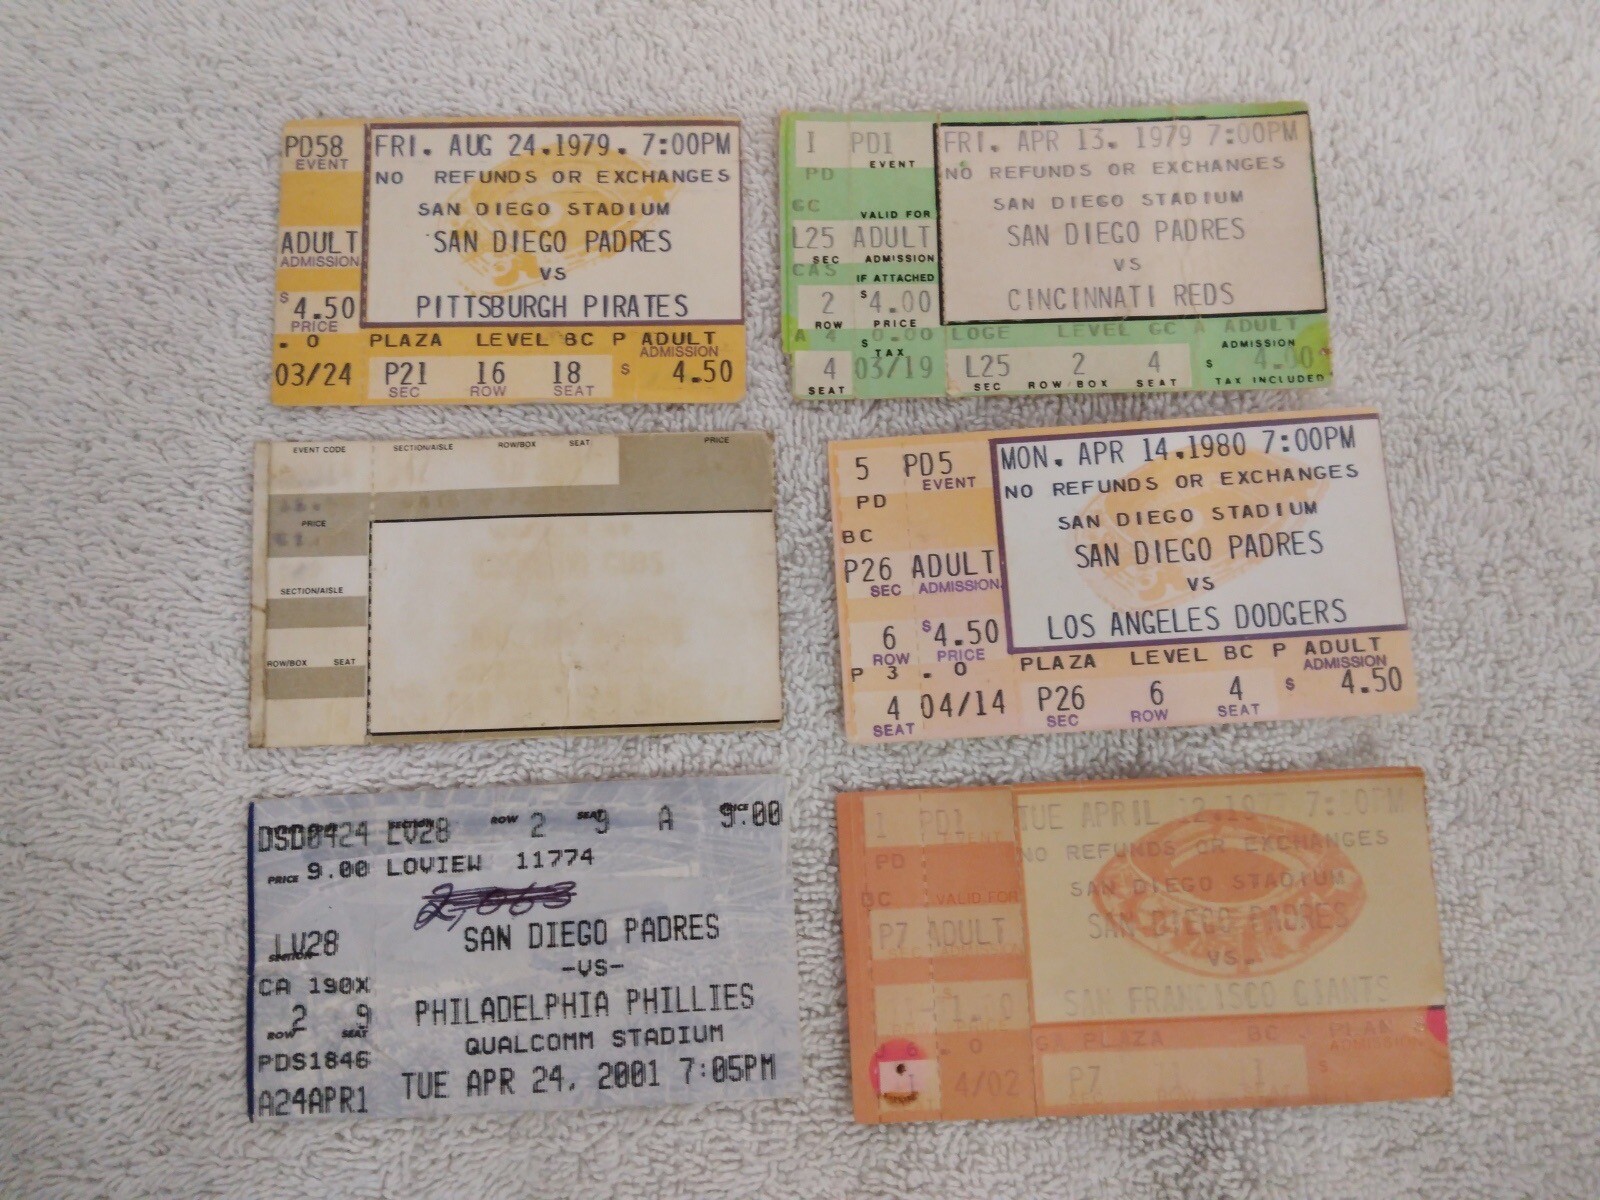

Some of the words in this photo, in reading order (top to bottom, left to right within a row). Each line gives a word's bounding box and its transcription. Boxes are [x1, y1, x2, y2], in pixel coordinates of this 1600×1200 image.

[284, 134, 343, 158] PD58
[450, 133, 492, 157] AUG
[643, 132, 730, 155] 7:00PM
[1017, 130, 1059, 151] APR
[1137, 125, 1192, 149] 1979
[1208, 120, 1298, 146] 7:00PM
[295, 159, 349, 170] EVENT
[870, 160, 915, 168] EVENT
[945, 167, 973, 180] NO
[990, 164, 1092, 179] REFUNDS
[1108, 163, 1135, 176] OR
[1153, 156, 1285, 174] EXCHANGES
[375, 171, 404, 184] NO
[434, 170, 537, 184] REFUNDS
[552, 170, 582, 183] OR
[597, 169, 730, 183] EXCHANGES
[418, 202, 461, 216] SAN
[476, 202, 551, 216] DIEGO
[567, 202, 671, 216] STADIUM
[993, 198, 1035, 211] SAN
[1051, 195, 1124, 210] DIEGO
[1142, 190, 1244, 206] STADIUM
[861, 210, 898, 219] VALID
[906, 210, 931, 218] FOR
[281, 230, 358, 254] ADULT
[433, 230, 478, 253] SAN
[493, 230, 567, 253] DIEGO
[585, 230, 672, 252] PADRES
[852, 226, 931, 248] ADULT
[1007, 224, 1050, 246] SAN
[1065, 221, 1140, 245] DIEGO
[1155, 218, 1245, 242] PADRES
[280, 256, 359, 268] ADMISSION
[812, 256, 840, 264] SEC
[865, 254, 935, 263] ADMISSION
[873, 274, 935, 282] ATTACHED
[417, 295, 567, 318] PITTSBURGH
[583, 294, 688, 317] PIRATES
[1008, 285, 1155, 311] CINCINNATI
[1173, 282, 1234, 306] REDS
[290, 321, 338, 332] PRICE
[815, 321, 843, 329] ROW
[873, 319, 917, 328] PRICE
[1057, 322, 1130, 338] LEVEL
[1225, 318, 1298, 333] ADULT
[369, 334, 442, 347] PLAZA
[476, 332, 549, 347] LEVEL
[565, 332, 593, 346] BC
[641, 331, 716, 345] ADULT
[1221, 339, 1296, 349] ADMISSION
[640, 346, 719, 357] ADMISSION
[275, 363, 351, 386] 03/24
[385, 361, 427, 385] P21
[477, 361, 505, 384] 16
[553, 361, 581, 384] 18
[965, 355, 1010, 378] L25
[974, 382, 1001, 391] SEC
[1137, 378, 1177, 388] SEAT
[1252, 374, 1324, 384] INCLUDED
[388, 386, 420, 398] SEC
[470, 385, 507, 397] ROW
[553, 385, 594, 396] SEAT
[808, 386, 845, 395] SEAT
[323, 445, 346, 453] CODE
[393, 443, 453, 452] SECTION/AISLE
[569, 439, 590, 447] SEAT
[704, 436, 730, 444] PRICE
[1078, 440, 1125, 466] APR
[1262, 425, 1357, 454] 7:00PM
[856, 456, 869, 480] 5
[904, 451, 953, 477] PD5
[922, 476, 976, 491] EVENT
[1005, 484, 1033, 499] NO
[1053, 476, 1158, 497] REFUNDS
[1175, 473, 1203, 489] OR
[1221, 464, 1359, 486] EXCHANGES
[857, 494, 887, 509] PD
[301, 520, 326, 528] PRICE
[1058, 515, 1101, 530] SAN
[1116, 508, 1194, 527] DIEGO
[1212, 501, 1318, 520] STADIUM
[842, 529, 873, 544] BC
[1075, 543, 1120, 569] SAN
[1134, 537, 1212, 565] DIEGO
[1228, 530, 1324, 560] PADRES
[844, 556, 892, 583] P26
[912, 550, 994, 579] ADULT
[280, 586, 344, 595] SECTION/AISLE
[870, 584, 902, 598] SEC
[1048, 613, 1096, 640] LOS
[1110, 606, 1220, 637] ANGELES
[1235, 598, 1347, 629] DODGERS
[882, 625, 896, 650] 6
[267, 659, 308, 668] ROW/BOX
[333, 658, 356, 666] SEAT
[873, 653, 910, 666] ROW
[937, 648, 985, 662] PRICE
[1020, 653, 1097, 671] PLAZA
[1130, 647, 1208, 665] LEVEL
[1224, 645, 1253, 661] BC
[1304, 637, 1380, 656] ADULT
[1303, 655, 1388, 671] ADMISSION
[887, 696, 900, 720] 4
[920, 690, 1005, 719] 04/14
[1038, 684, 1085, 712] P26
[1046, 714, 1079, 728] SEC
[1131, 709, 1168, 723] ROW
[1218, 703, 1259, 717] SEAT
[873, 723, 915, 738] SEAT
[657, 804, 674, 830] A
[1081, 800, 1159, 827] APRIL
[530, 812, 546, 838] 2
[1066, 840, 1176, 861] REFUNDS
[1245, 830, 1389, 852] EXCHANGES
[387, 855, 482, 877] LOVIEW
[517, 848, 594, 869] 11774
[267, 875, 299, 884] PRICE
[1071, 881, 1116, 897] SAN
[1133, 876, 1213, 894] DIEGO
[1232, 869, 1345, 890] STADIUM
[464, 925, 512, 952] SAN
[528, 919, 608, 949] DIEGO
[625, 913, 719, 943] PADRES
[878, 922, 908, 950] P7
[928, 918, 1005, 948] ADULT
[259, 977, 292, 997] CA
[309, 977, 371, 995] 190X
[1293, 975, 1389, 1007] GIANTS
[415, 991, 609, 1027] PHILADELPHIA
[626, 983, 754, 1015] PHILLIES
[292, 1003, 307, 1031] 2
[356, 1003, 372, 1029] 9
[341, 1029, 369, 1038] SEAT
[465, 1031, 593, 1055] QUALCOMM
[611, 1024, 723, 1048] STADIUM
[258, 1051, 371, 1073] PDS1846
[401, 1071, 450, 1100] TUE
[467, 1067, 515, 1098] APR
[598, 1060, 660, 1089] 2001
[679, 1053, 776, 1085] 7:05PM
[258, 1085, 369, 1116] A24APR1
